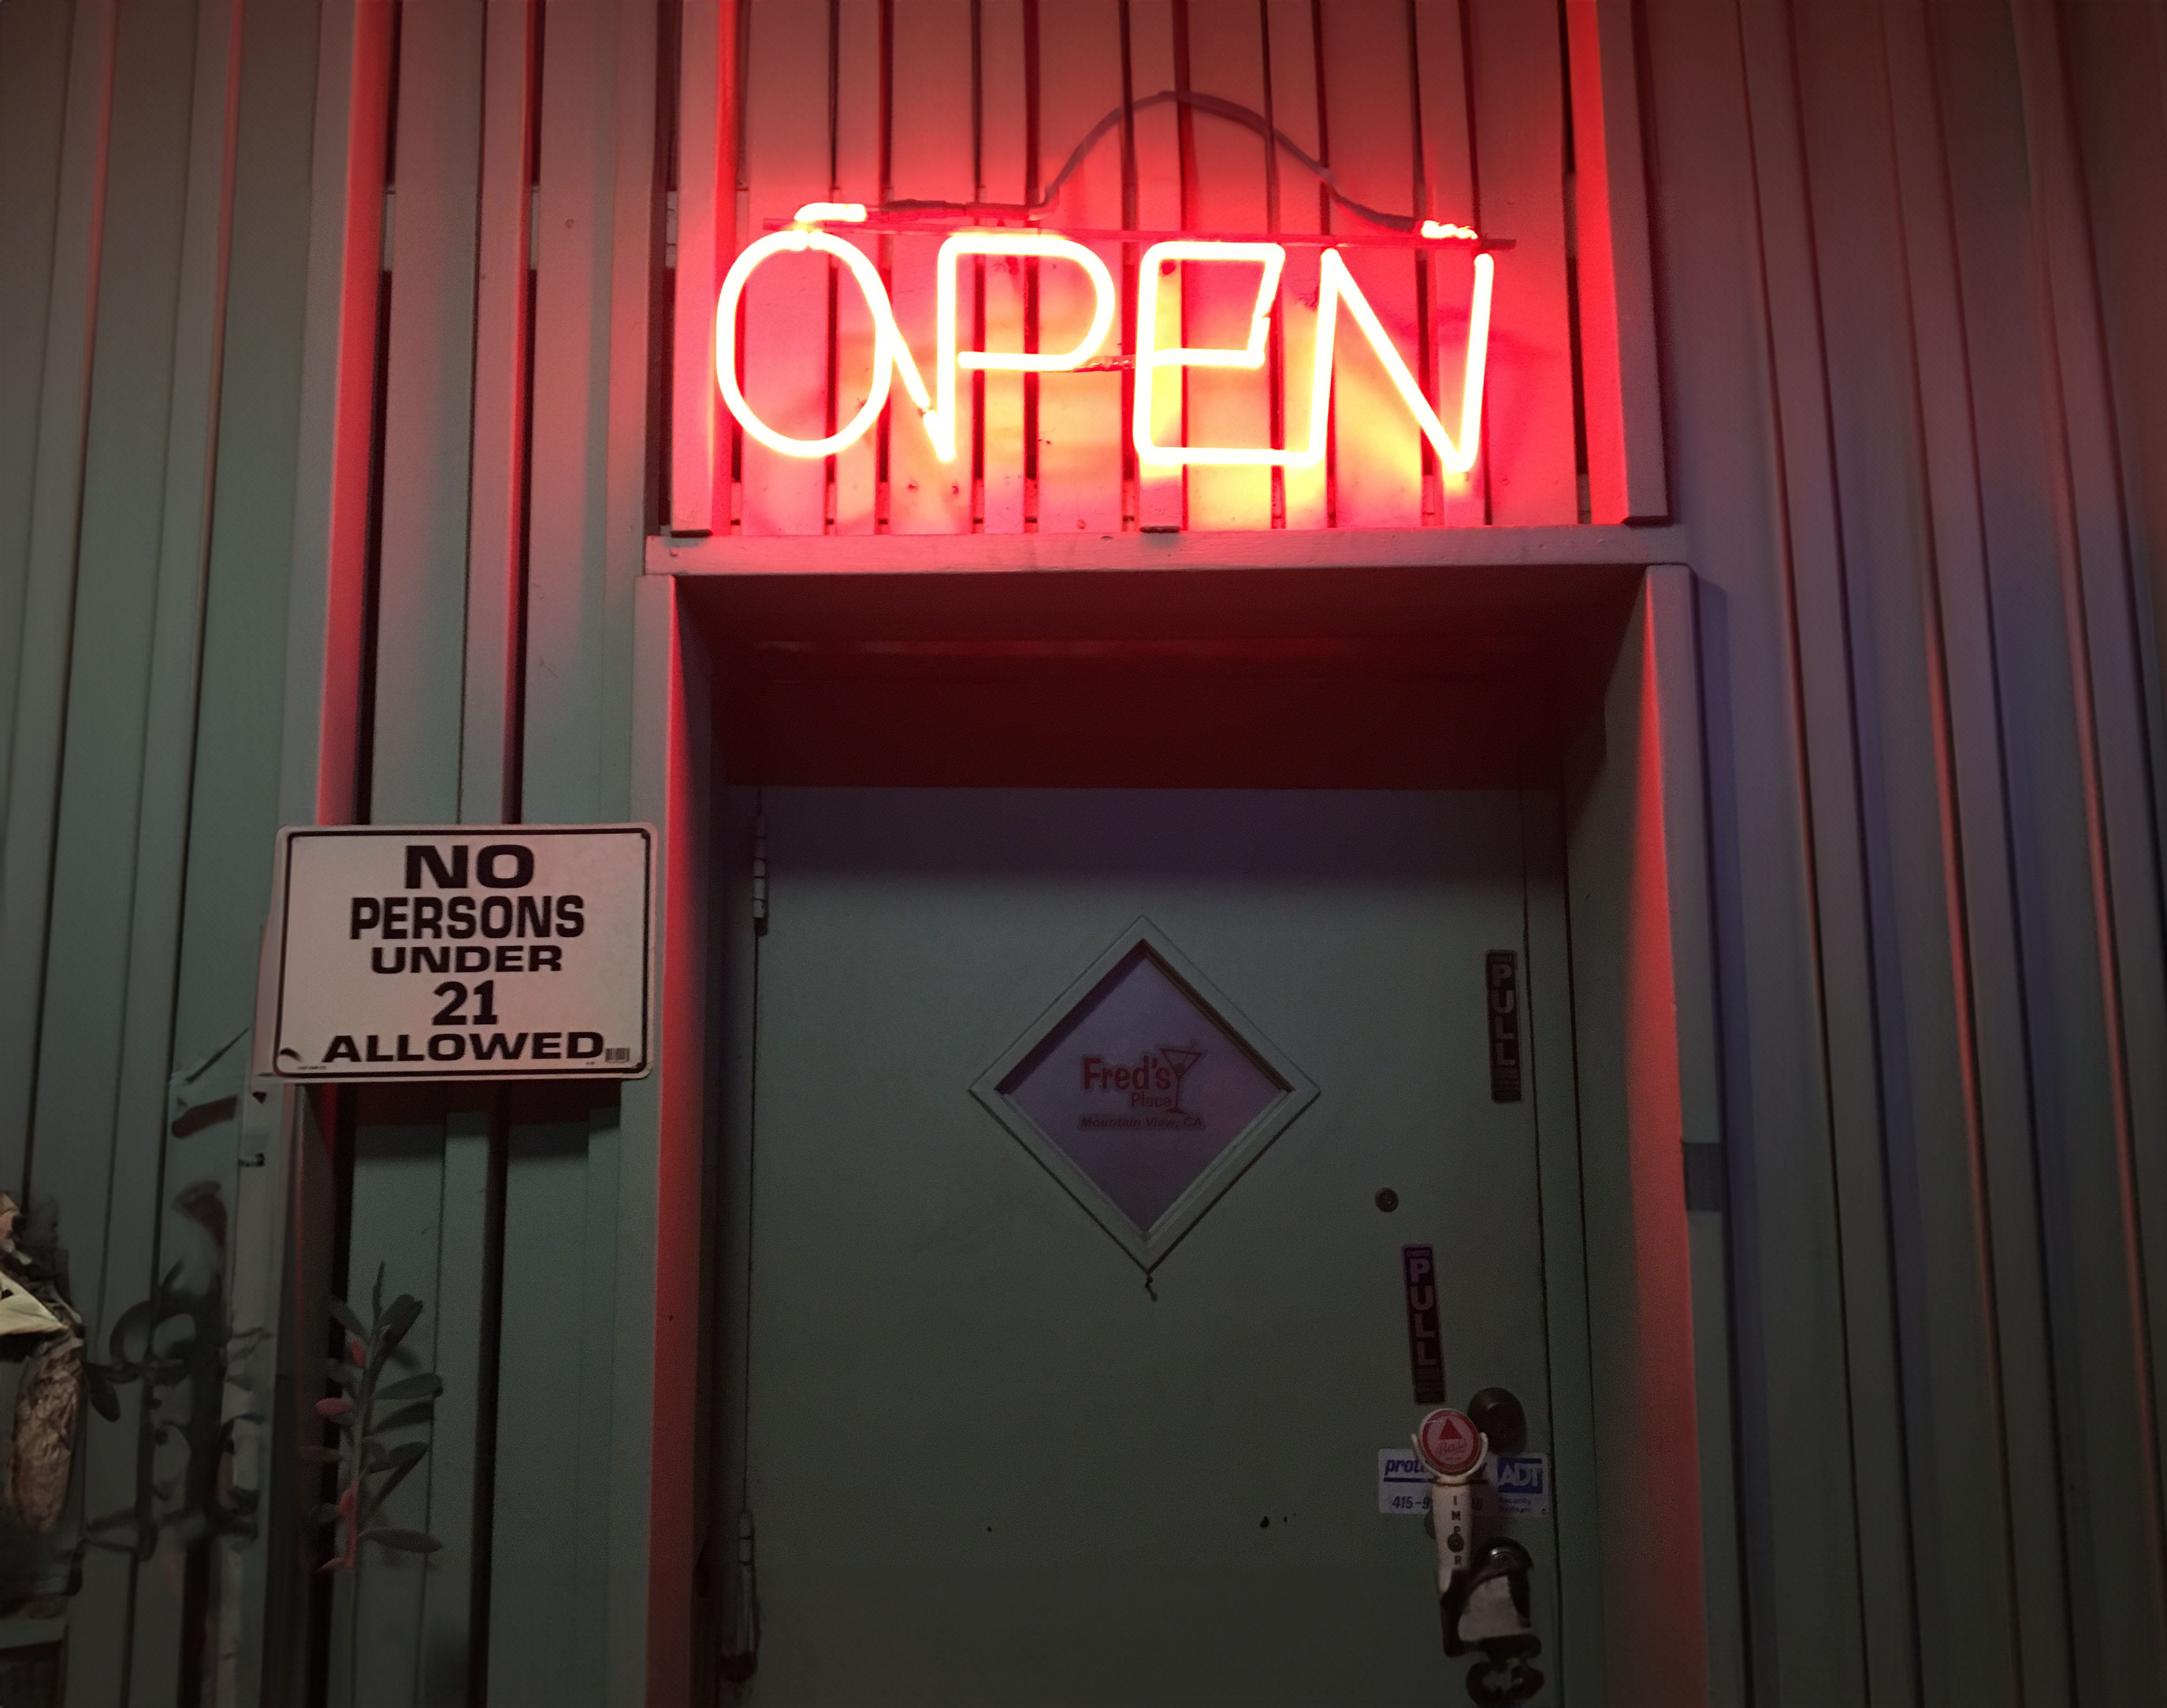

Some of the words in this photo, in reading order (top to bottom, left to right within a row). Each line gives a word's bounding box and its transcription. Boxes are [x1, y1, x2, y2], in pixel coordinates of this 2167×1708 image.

[715, 230, 1495, 473] OPEN
[405, 844, 534, 889] NO
[349, 894, 585, 940] PERSONS
[371, 945, 563, 974] UNDER
[432, 979, 499, 1026] 21
[1491, 964, 1516, 1066] PULL
[322, 1031, 604, 1063] ALLOWED
[1084, 1055, 1171, 1090] Fred's
[1130, 1091, 1172, 1108] Place
[1081, 1117, 1141, 1128] Mountain
[1146, 1117, 1178, 1129] View,
[1183, 1117, 1202, 1128] CA
[1409, 1258, 1438, 1366] PULL
[1498, 1462, 1543, 1487] ADT
